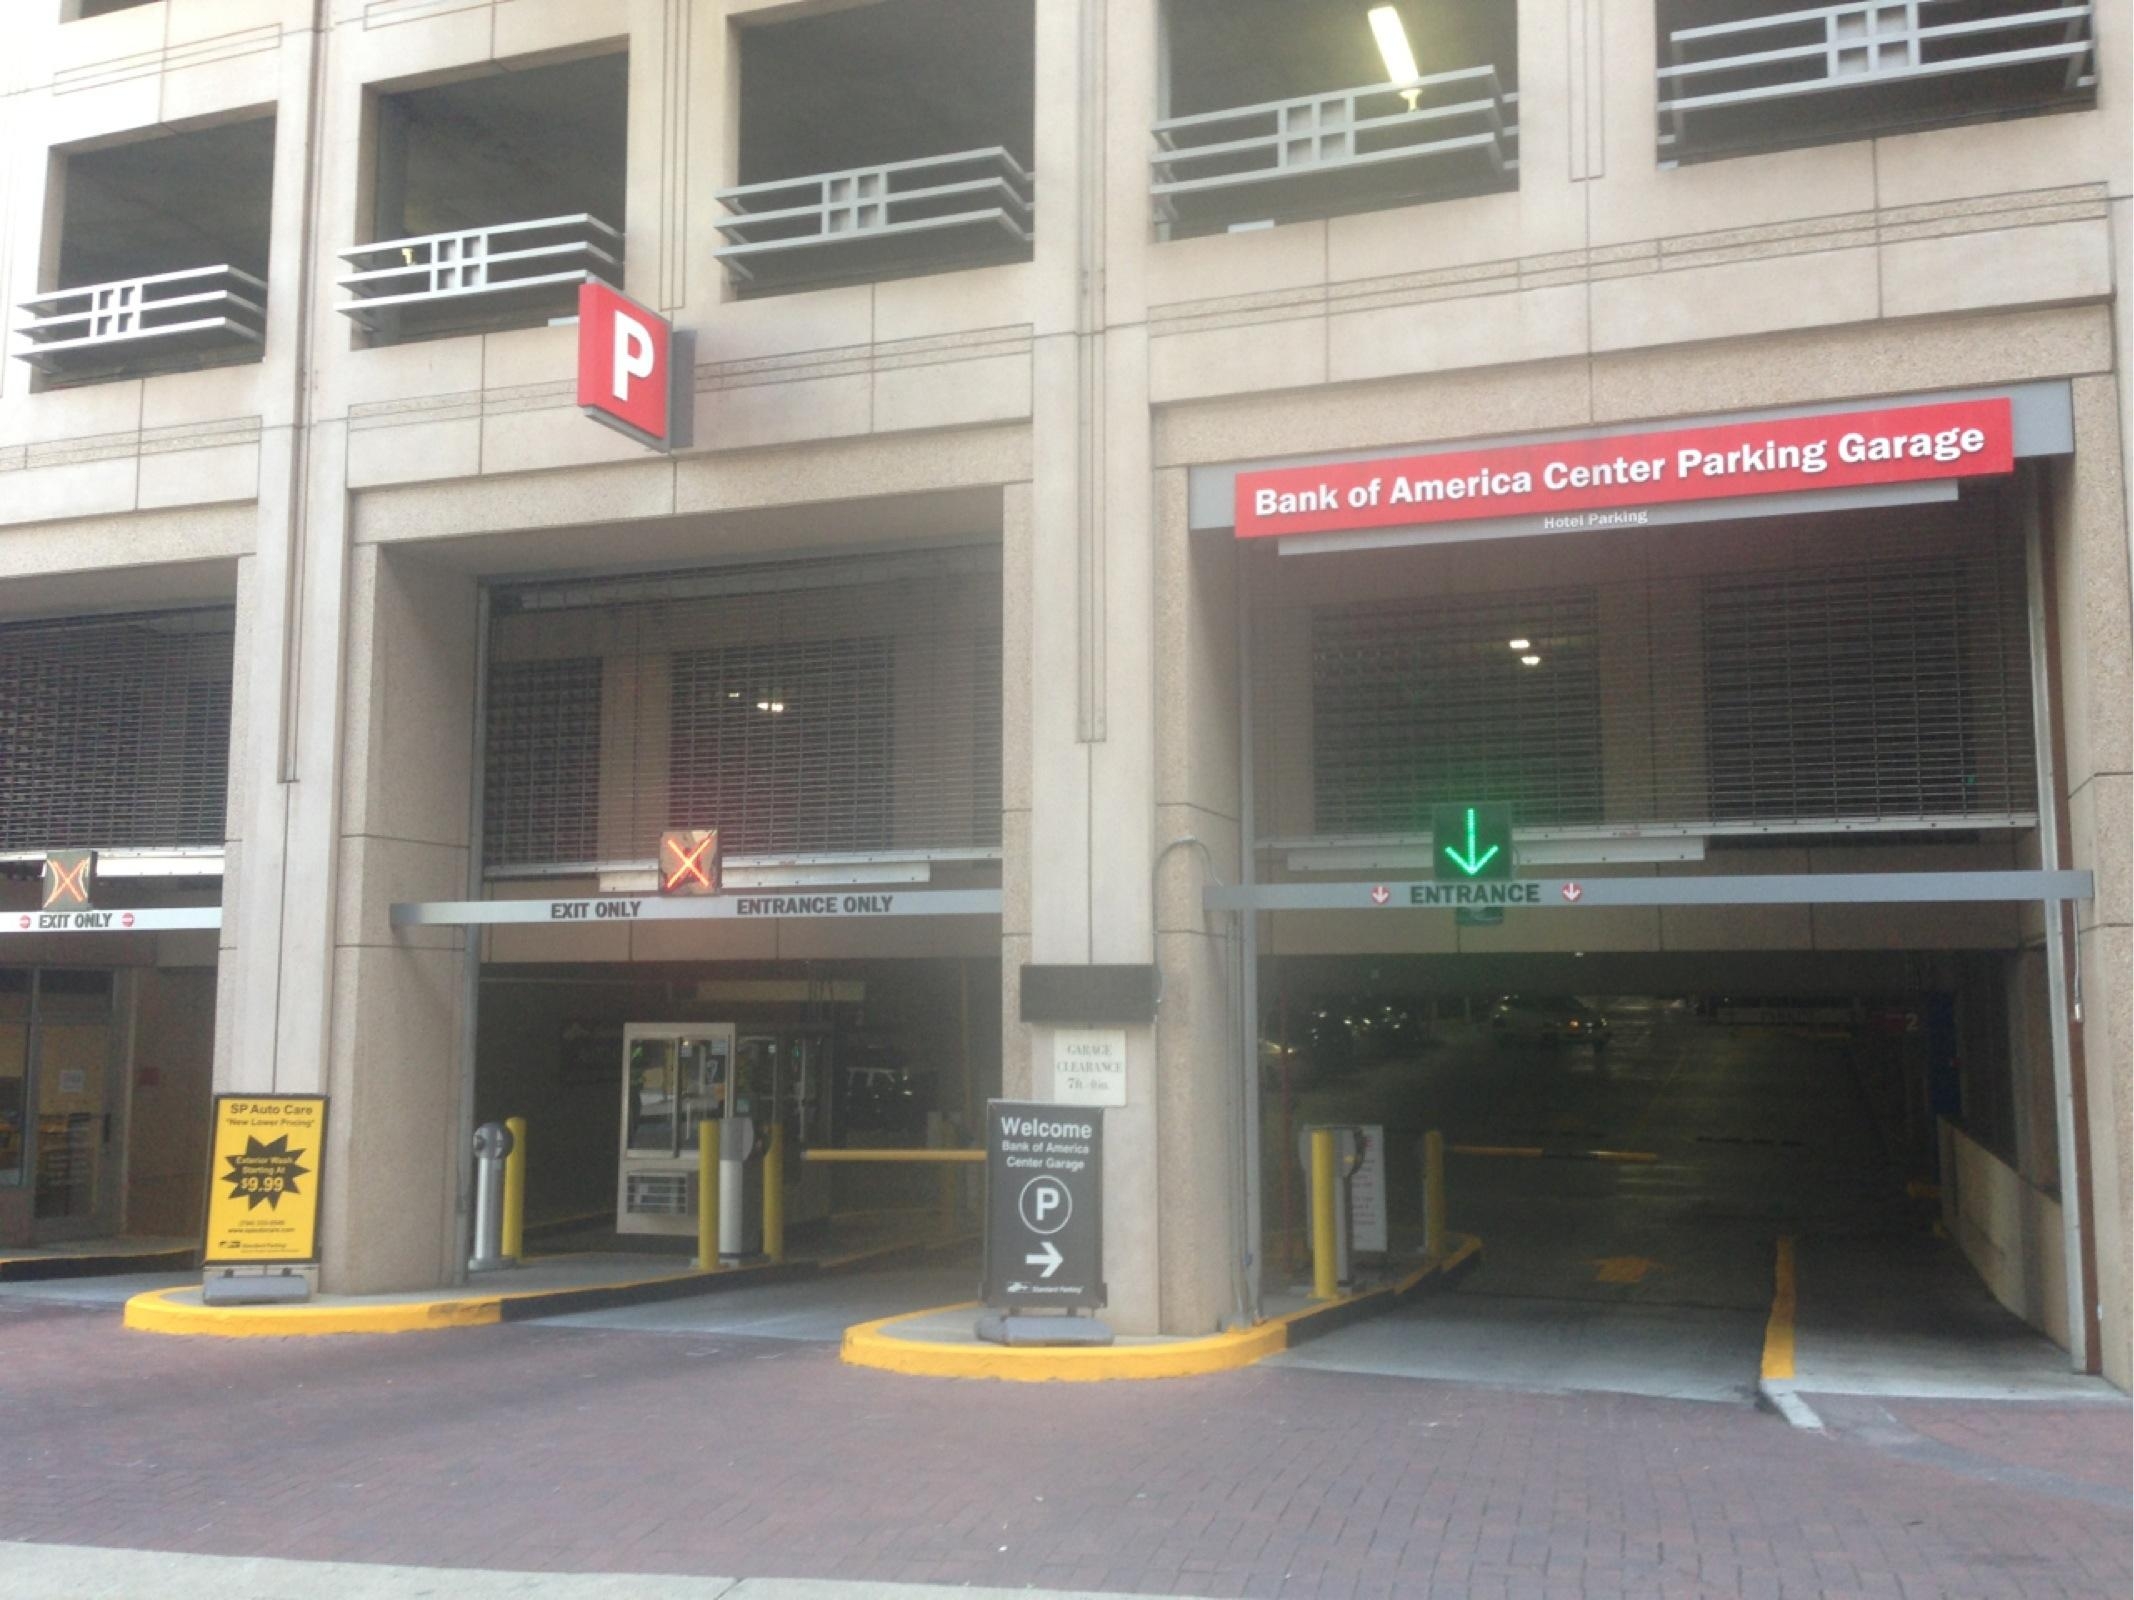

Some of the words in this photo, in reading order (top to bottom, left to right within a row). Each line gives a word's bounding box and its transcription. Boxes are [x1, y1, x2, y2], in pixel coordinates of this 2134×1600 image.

[612, 309, 656, 403] P
[1254, 484, 1340, 517] Bank
[1347, 477, 1382, 509] of
[1388, 470, 1533, 505] America
[1543, 456, 1666, 490] Center
[1676, 440, 1829, 479] Parking
[1837, 426, 1986, 464] Garage
[1544, 513, 1585, 530] Hotel
[1587, 510, 1649, 528] Parking
[1409, 883, 1541, 904] ENTRANCE
[550, 902, 590, 919] EXIT
[594, 901, 642, 918] ONLY
[736, 897, 839, 916] ENTRANCE
[842, 895, 894, 914] ONLY
[38, 914, 71, 929] EXIT
[74, 912, 113, 928] ONLY
[1067, 1043, 1113, 1056] GARAGE
[1056, 1061, 1123, 1073] CLEARANCE
[230, 1104, 249, 1114] SP
[250, 1104, 280, 1114] Auto
[284, 1104, 313, 1115] Care
[1001, 1116, 1092, 1139] Welcome
[1002, 1140, 1029, 1152] Bank
[1032, 1141, 1044, 1152] of
[1046, 1142, 1089, 1154] America
[1007, 1156, 1042, 1168] Center
[1046, 1157, 1084, 1172] Garage
[241, 1176, 284, 1192] $9.99
[1035, 1187, 1061, 1221] P
